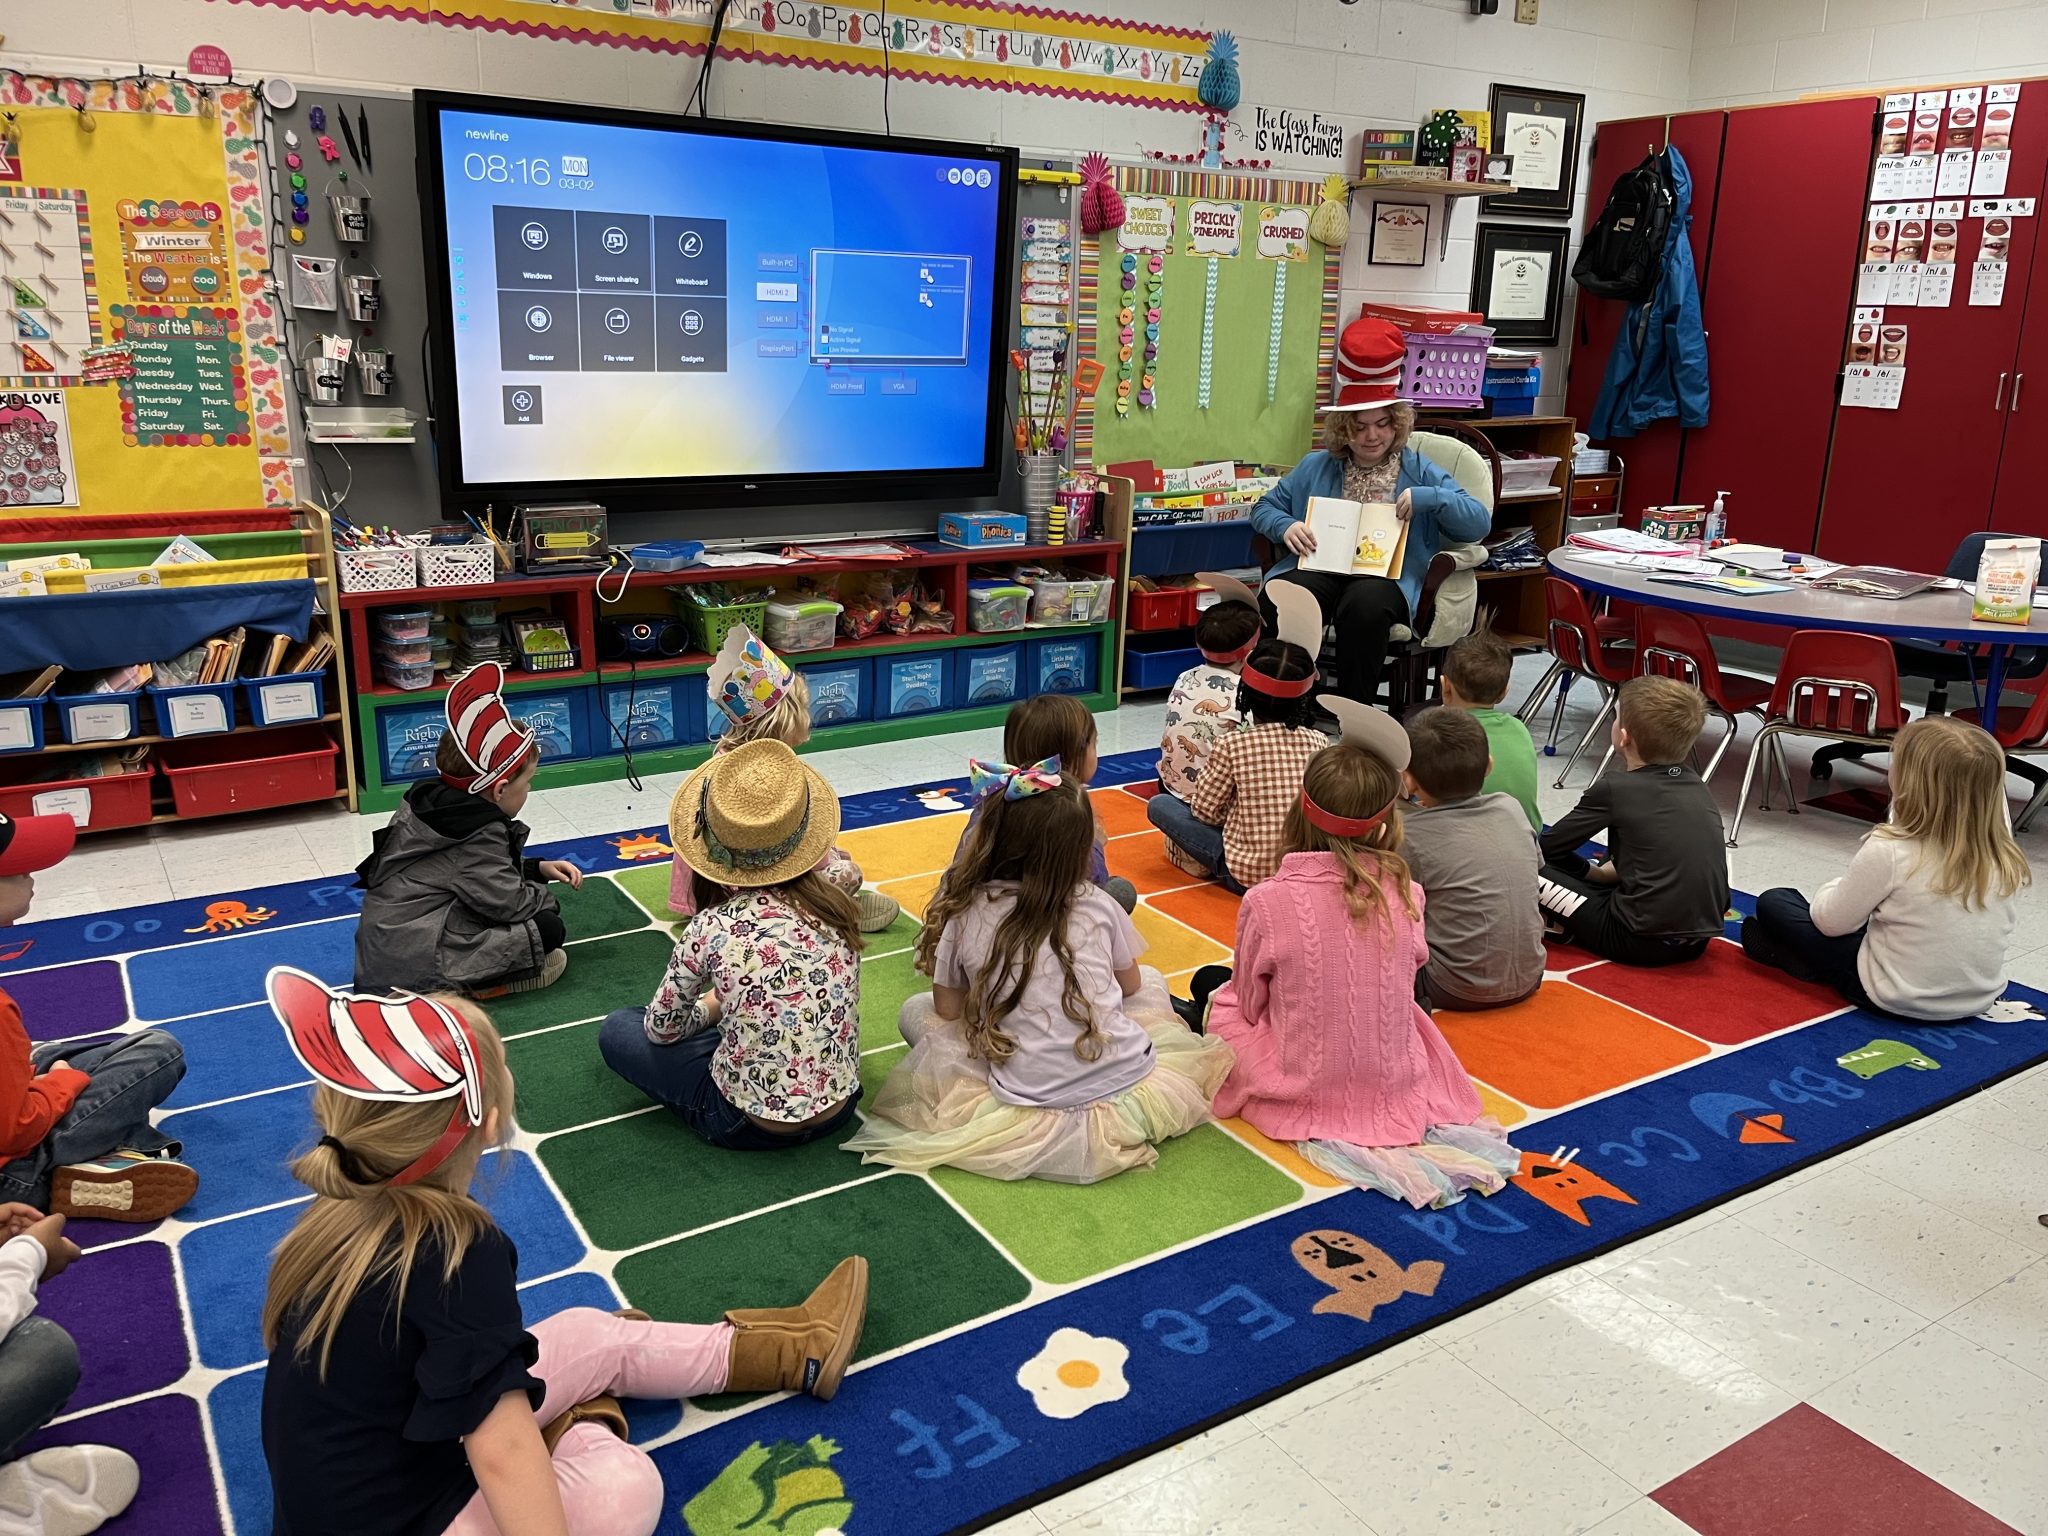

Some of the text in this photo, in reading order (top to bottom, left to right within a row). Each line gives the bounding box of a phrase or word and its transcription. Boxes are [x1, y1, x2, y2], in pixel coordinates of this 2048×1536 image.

[823, 6, 848, 42] Pp
[943, 25, 962, 48] Ss
[1010, 37, 1032, 58] Uu
[1042, 38, 1060, 60] Vv
[1070, 41, 1103, 65] Ww
[1118, 47, 1138, 70] Xx
[1151, 52, 1170, 83] Yy
[1182, 56, 1199, 78] Zz
[1992, 90, 1998, 99] p
[1256, 107, 1278, 129] The
[1313, 114, 1342, 140] Fairy
[466, 128, 509, 142] newline
[1256, 130, 1342, 158] IS WATCHING!
[464, 153, 588, 186] 08:16 MON
[559, 179, 594, 190] 03-02
[6, 200, 72, 213] Friday Saturday
[124, 204, 216, 220] The Season is
[2006, 203, 2012, 212] k
[1130, 208, 1162, 222] SWEET
[1194, 212, 1236, 227] PRICKLY
[1124, 222, 1168, 236] CHOICES
[1194, 226, 1235, 238] PINEAPPLE
[1263, 226, 1304, 240] CRUSHED
[145, 236, 201, 246] Winter
[130, 252, 220, 264] The Weather is
[142, 274, 166, 286] cloudy
[194, 276, 216, 284] cool
[523, 272, 552, 280] Windows
[616, 276, 639, 285] sharing
[676, 278, 708, 286] Whiteboard
[128, 319, 224, 337] Days of the Week
[132, 342, 168, 351] Sunday
[134, 355, 221, 364] Monday Mon.
[681, 356, 704, 364] Gadgets
[198, 370, 223, 378] Tues.
[1517, 376, 1530, 384] Cards
[136, 382, 193, 392] Wednesday
[24, 393, 61, 404] LOVE
[137, 396, 230, 405] Thursday Thurs.
[138, 409, 168, 418] Friday
[140, 422, 184, 431] Saturday
[1200, 474, 1210, 484] CAN
[1211, 469, 1222, 478] LICK
[1217, 509, 1238, 522] HOP
[982, 524, 1012, 538] Phonics
[818, 686, 846, 698] Rigby
[626, 703, 660, 718] Rigby
[520, 716, 556, 730] Rigby
[404, 726, 442, 742] Rigby
[1142, 1284, 1295, 1355] Ee
[889, 1394, 1021, 1480] Ff
